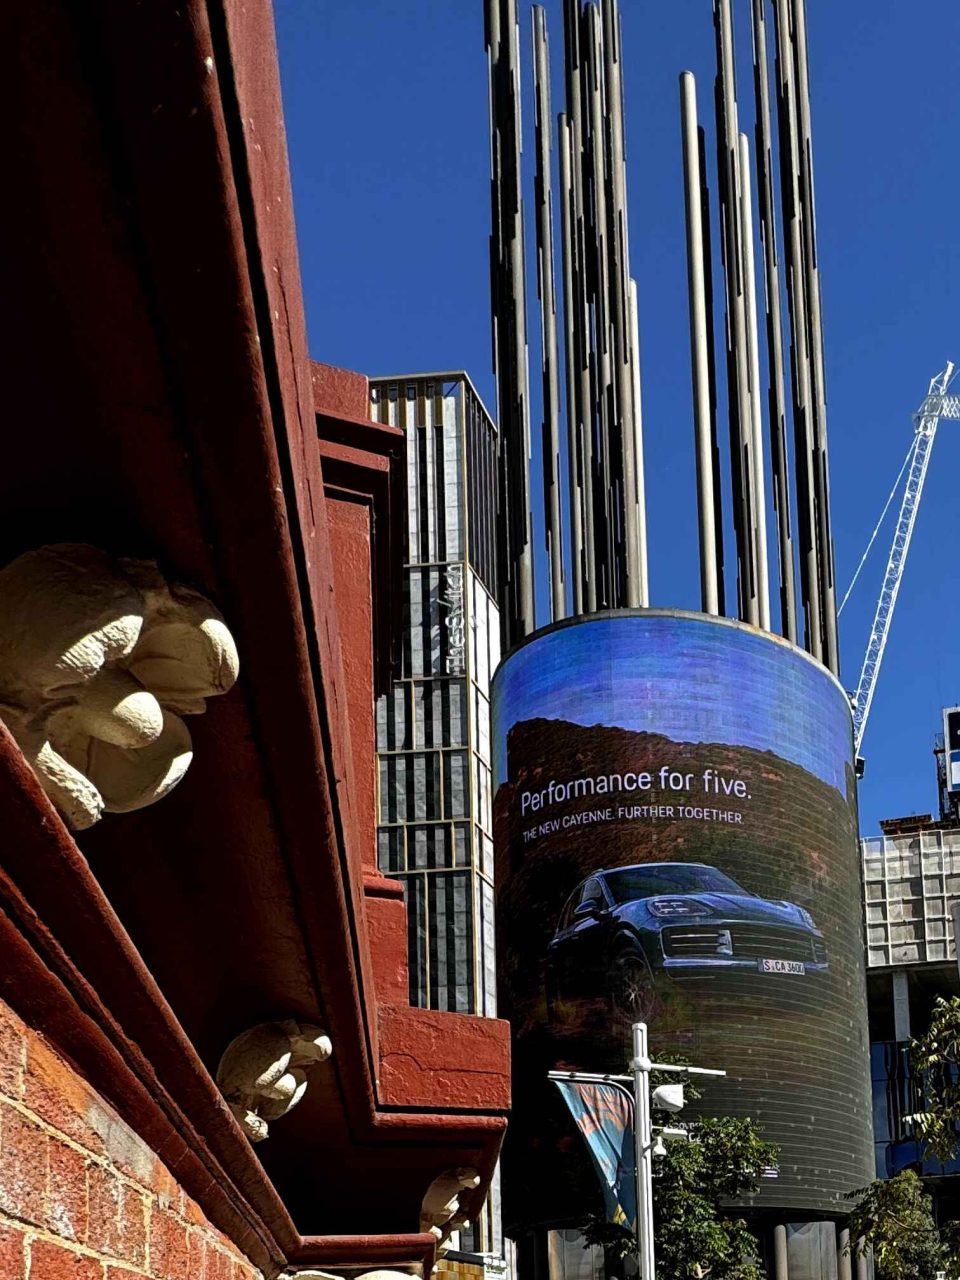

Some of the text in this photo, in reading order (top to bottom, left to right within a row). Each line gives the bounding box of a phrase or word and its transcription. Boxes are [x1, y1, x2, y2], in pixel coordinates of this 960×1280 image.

[521, 766, 752, 817] Performance for five.
[523, 805, 745, 844] THE NEW CAYENNE. FURTHER TOGETHER.
